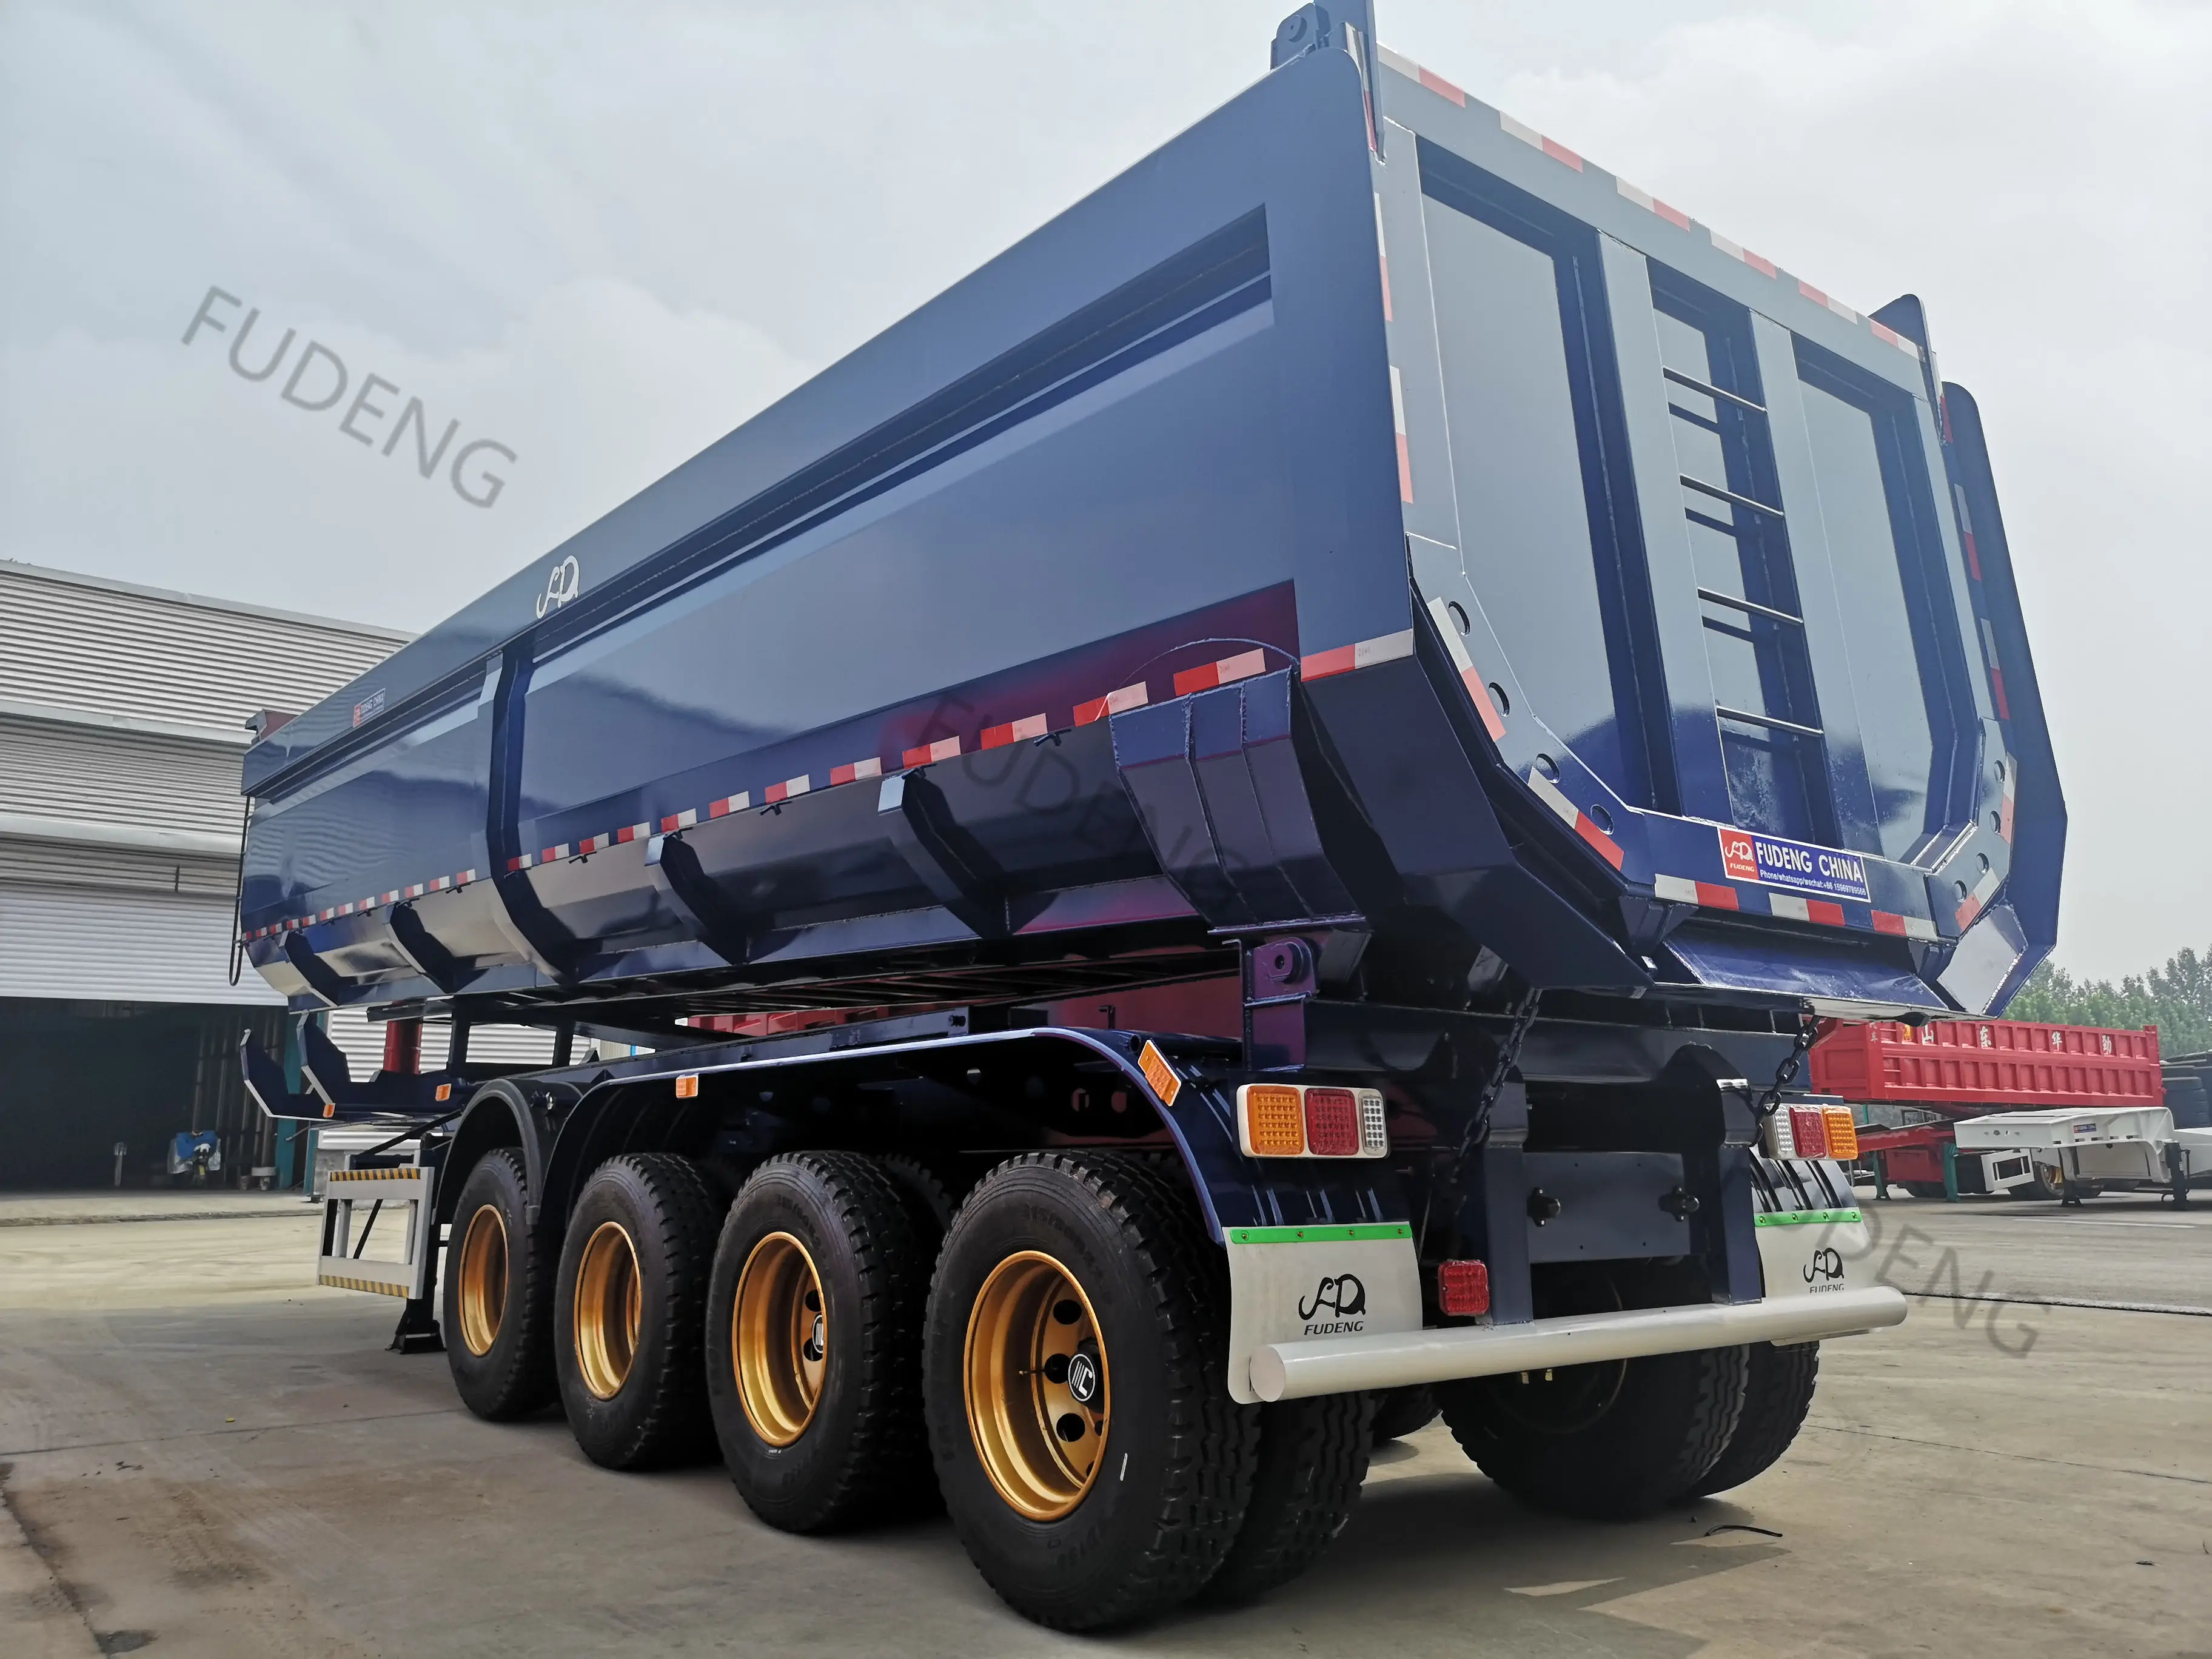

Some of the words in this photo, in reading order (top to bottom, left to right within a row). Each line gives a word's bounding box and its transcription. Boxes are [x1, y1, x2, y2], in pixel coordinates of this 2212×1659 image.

[1730, 863, 1755, 872] FUDENG
[1755, 842, 1812, 873] FUDENG
[1818, 854, 1863, 883] CHINA
[1304, 1321, 1364, 1336] FUDENG
